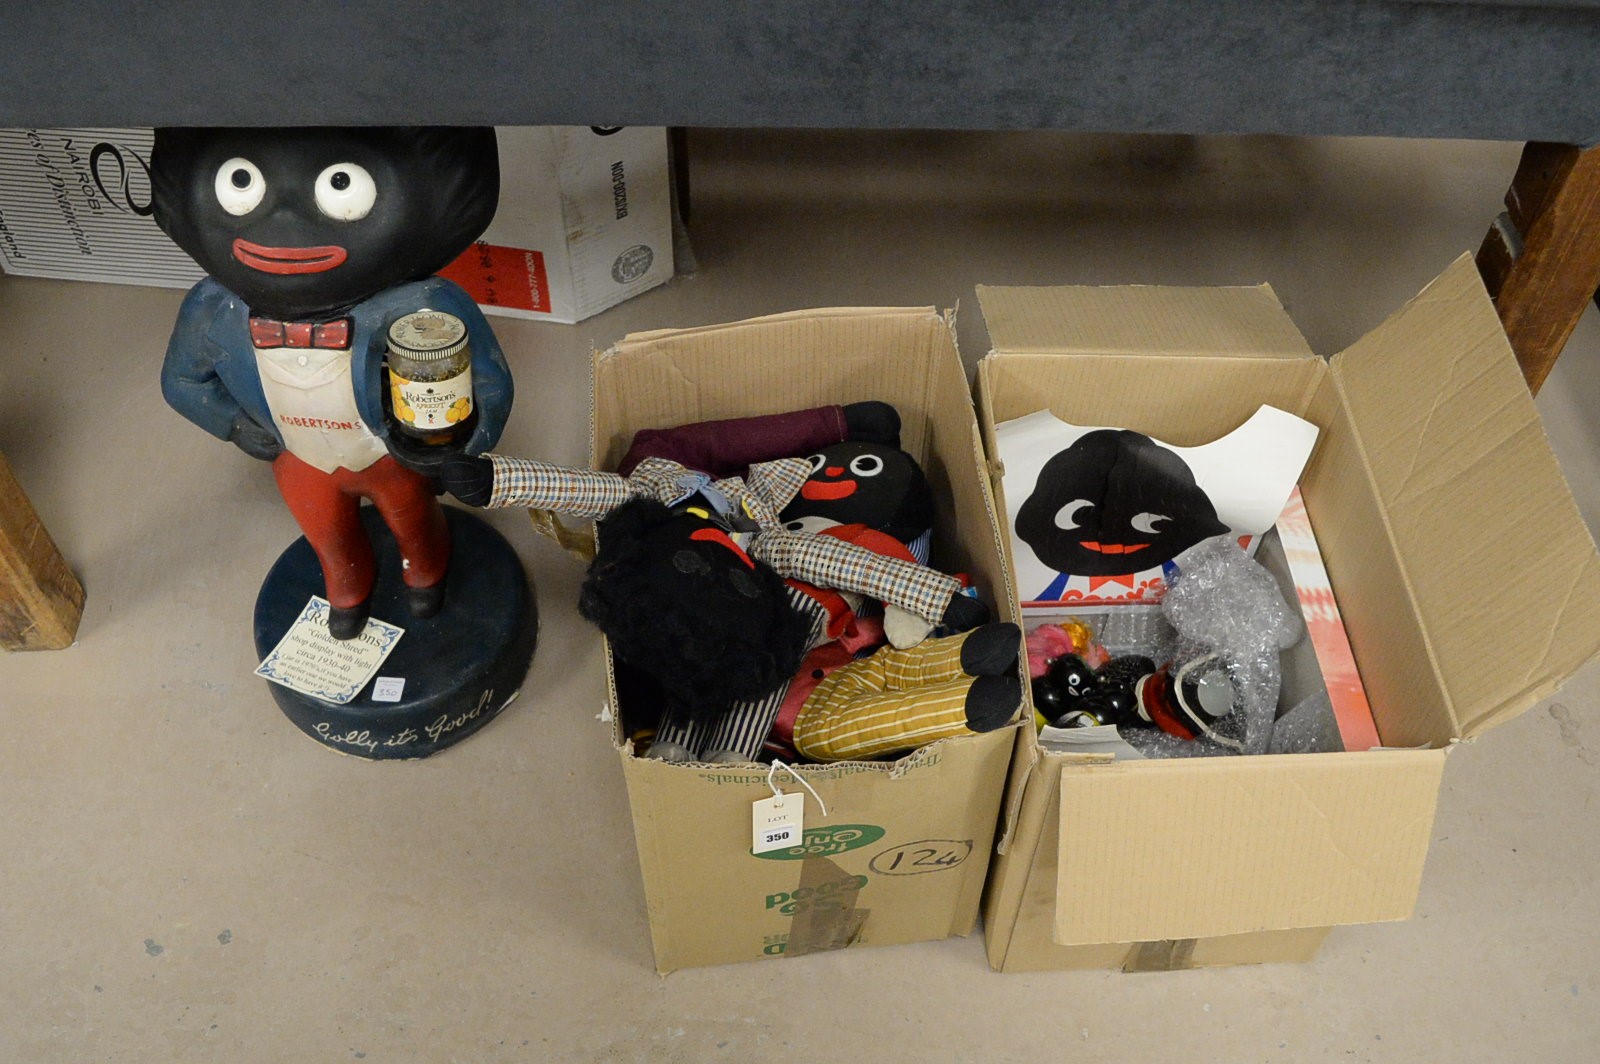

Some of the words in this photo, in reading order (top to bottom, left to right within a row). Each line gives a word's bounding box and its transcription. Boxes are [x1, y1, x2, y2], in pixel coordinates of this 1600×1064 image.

[60, 138, 104, 215] NAIROBI
[405, 390, 456, 403] Robertson's
[416, 401, 446, 409] APRICOT
[309, 611, 383, 648] Roons
[291, 634, 309, 649] shop
[309, 640, 336, 658] display
[337, 649, 353, 664] with
[354, 654, 373, 670] light
[296, 649, 316, 662] circa
[313, 722, 378, 753] Golly
[425, 688, 494, 743] Good!
[767, 813, 788, 823] LOT
[766, 830, 790, 843] 350
[788, 842, 847, 855] free
[889, 848, 964, 871] 124
